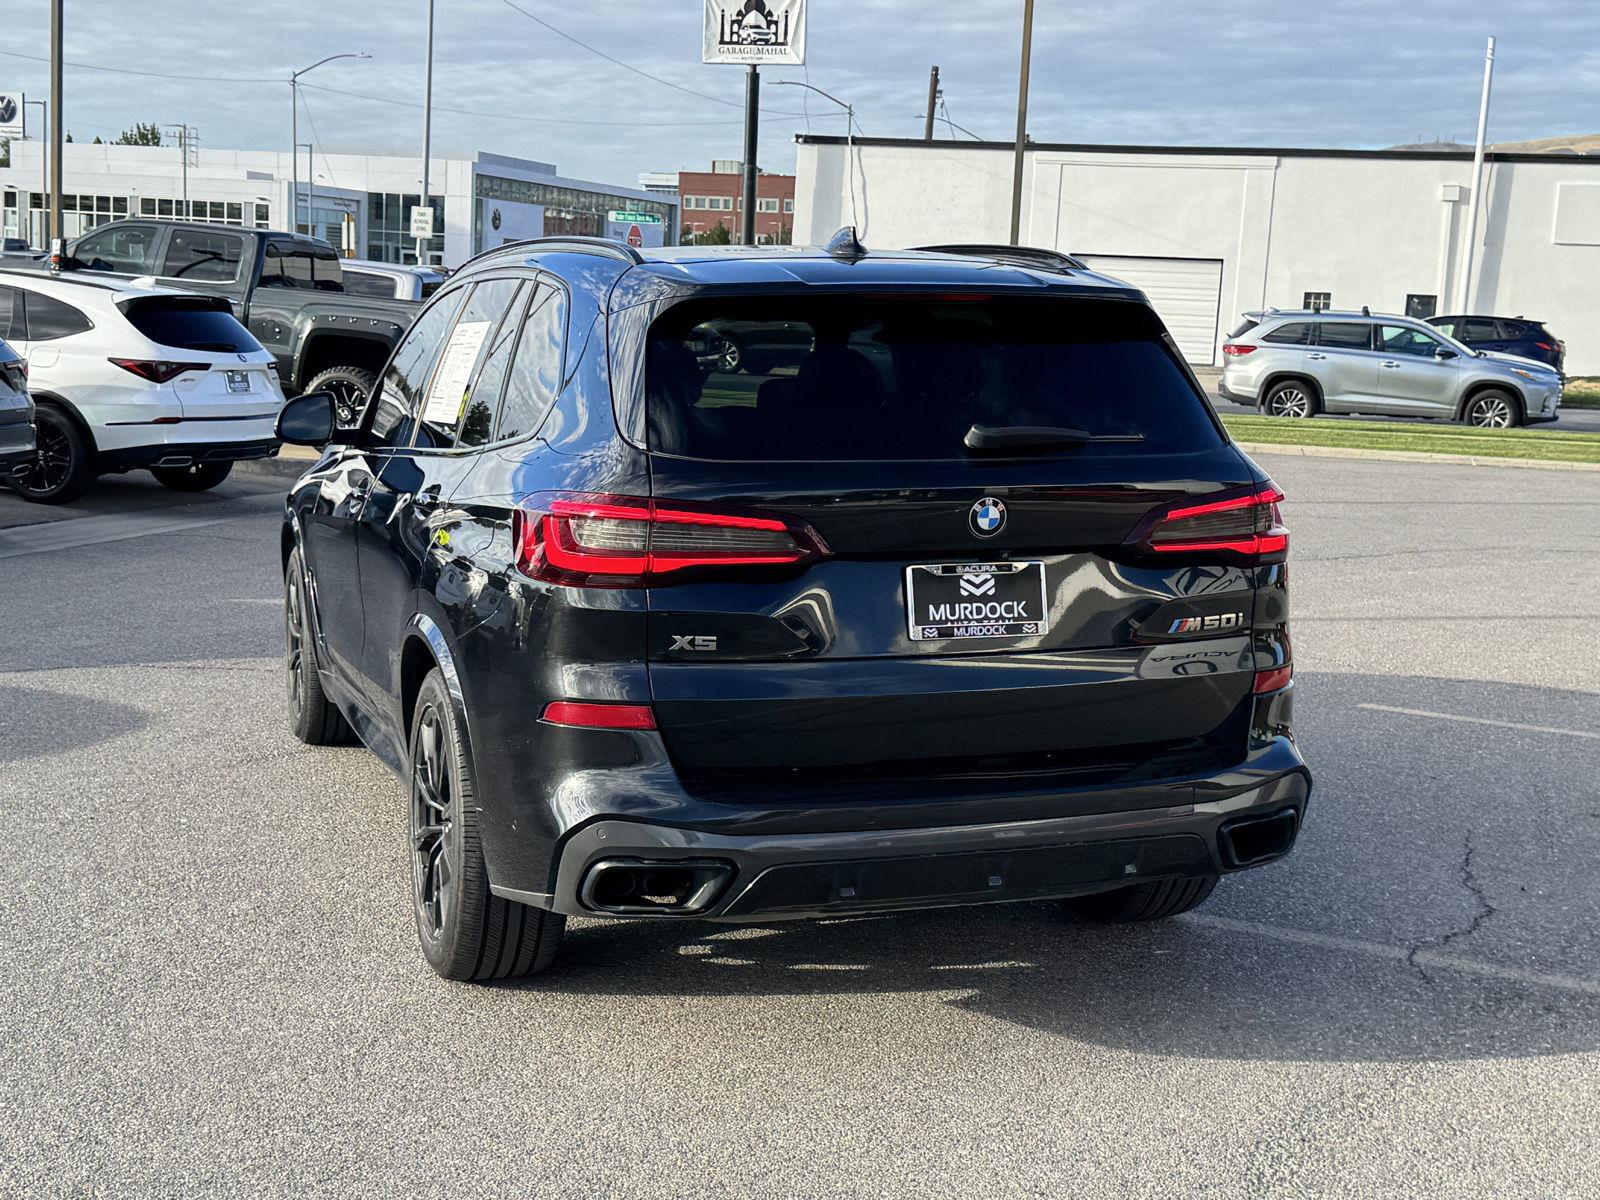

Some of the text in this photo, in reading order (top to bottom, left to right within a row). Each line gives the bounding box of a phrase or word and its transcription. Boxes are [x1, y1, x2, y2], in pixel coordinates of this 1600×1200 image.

[928, 600, 1028, 621] MURDOCK
[953, 625, 1007, 637] MURDOCK
[668, 634, 717, 651] X5
